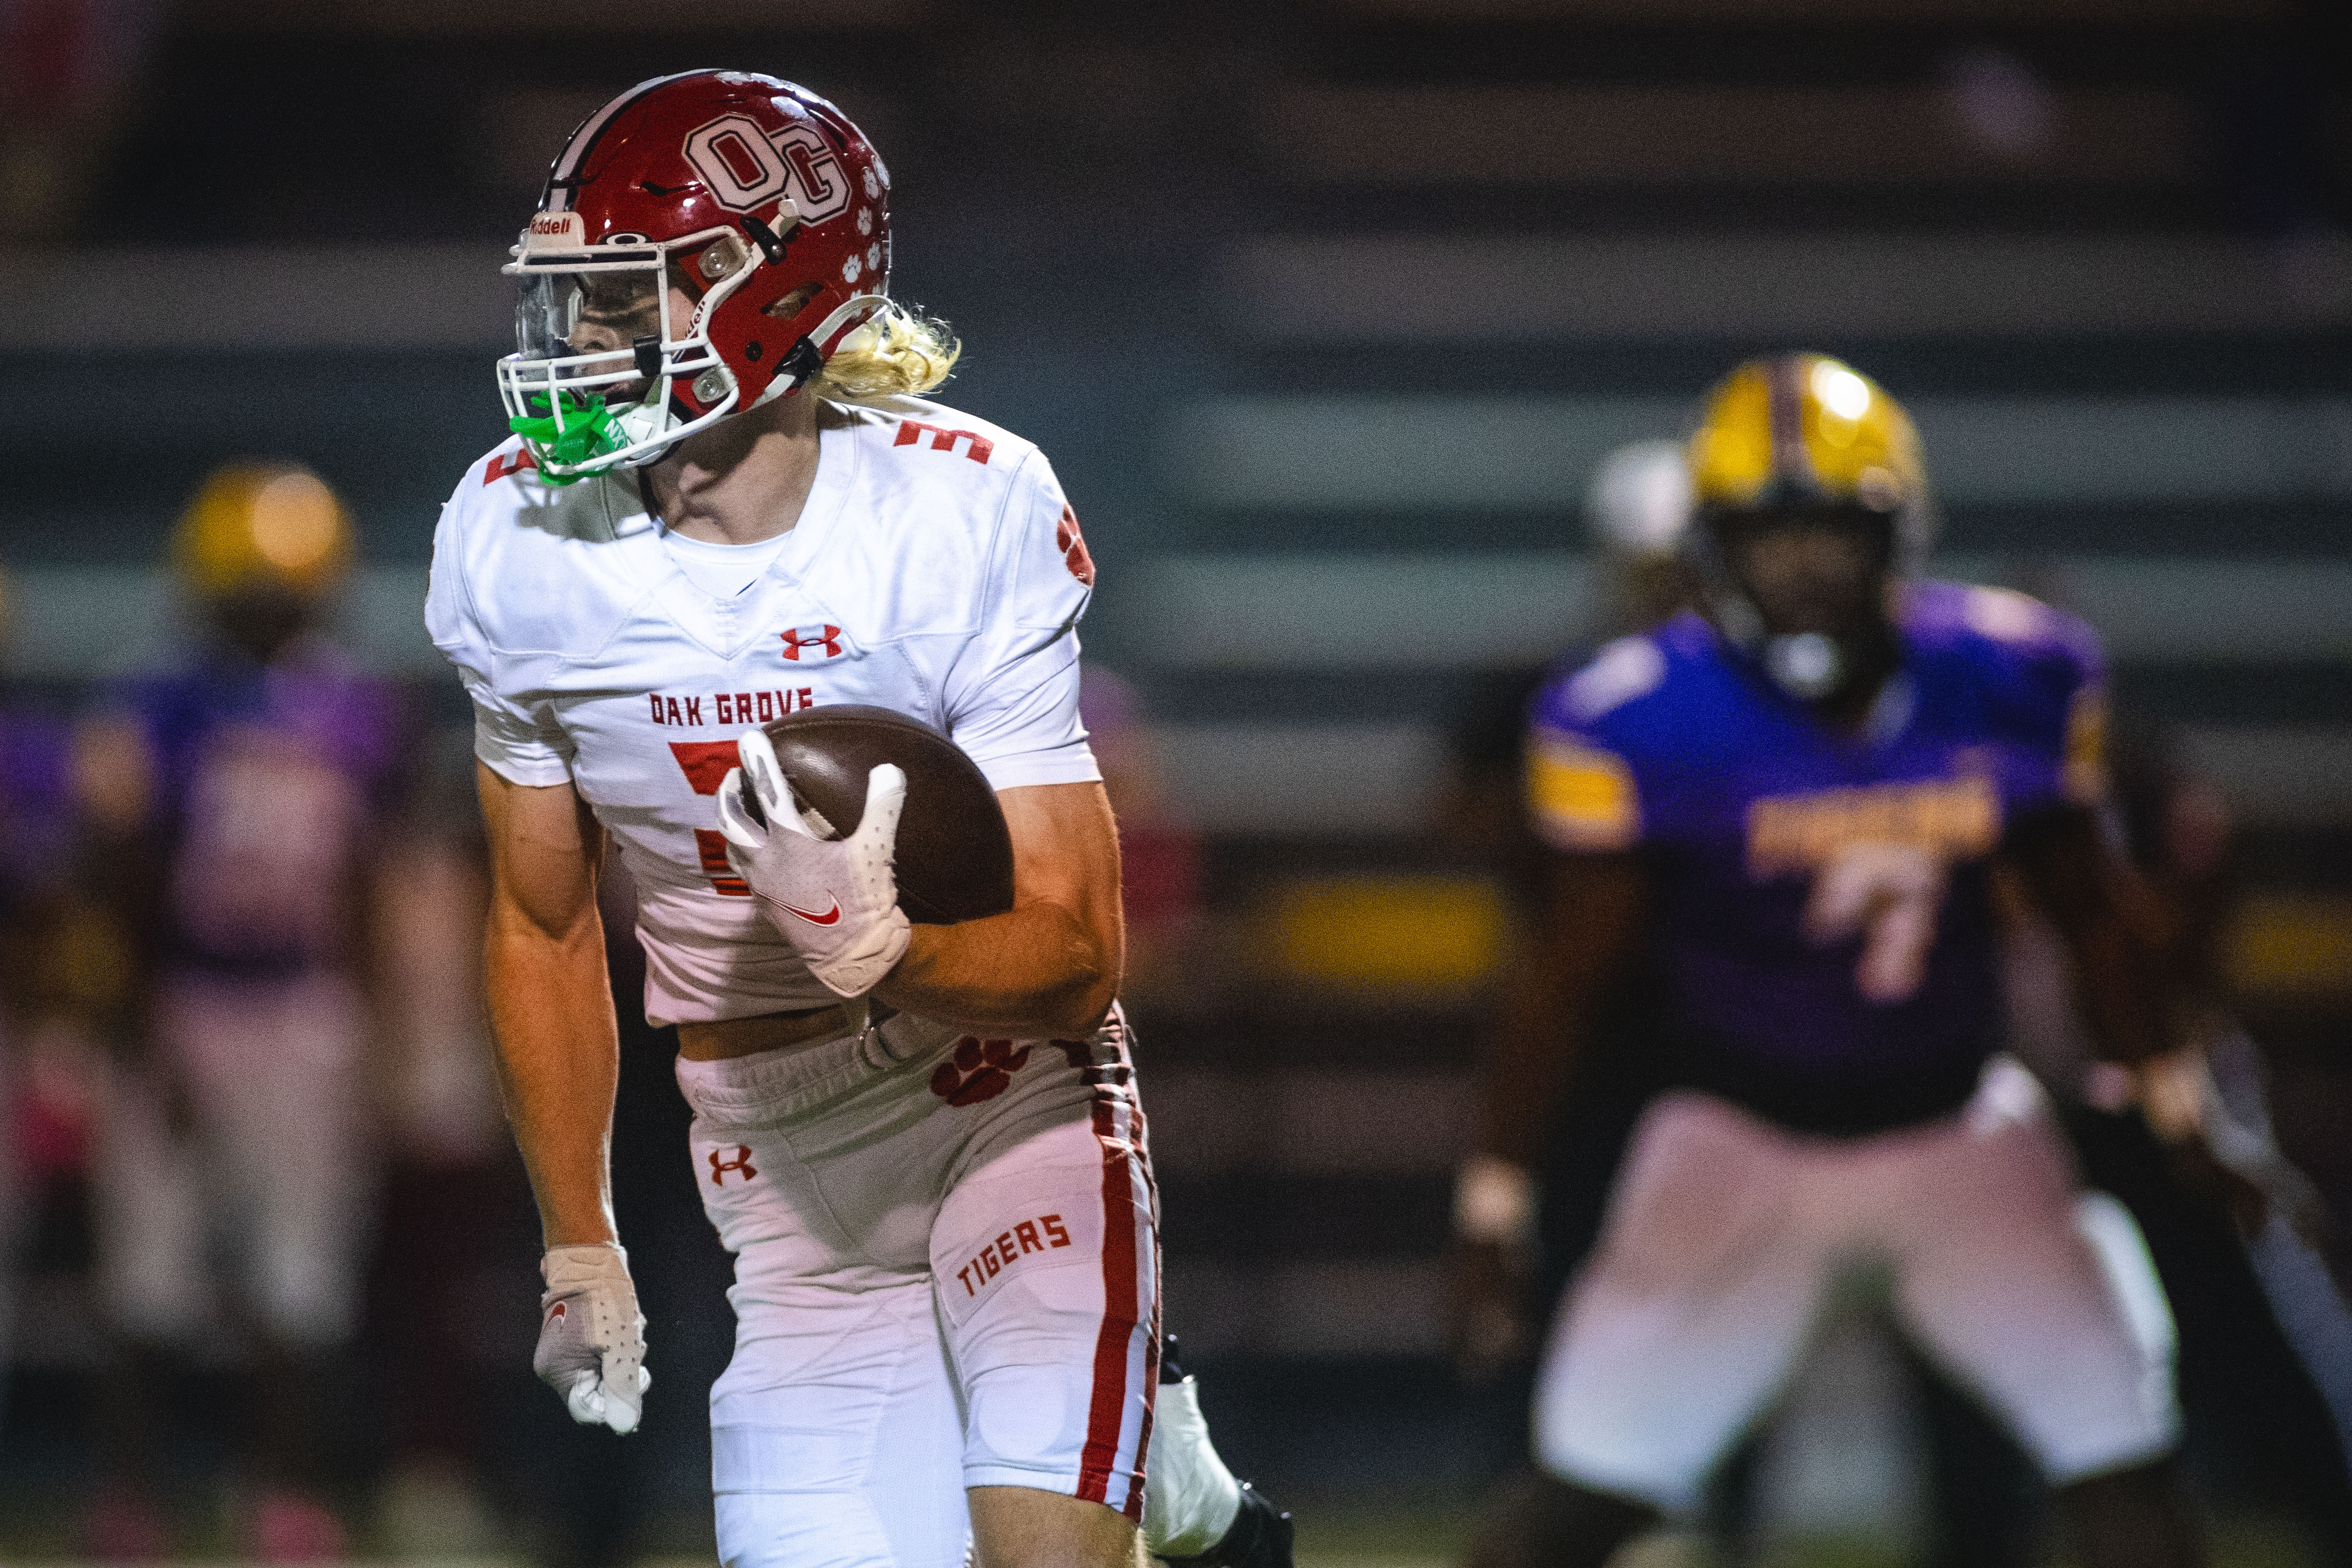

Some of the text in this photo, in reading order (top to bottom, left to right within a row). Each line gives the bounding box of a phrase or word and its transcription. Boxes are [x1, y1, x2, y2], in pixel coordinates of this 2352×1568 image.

[681, 111, 852, 227] OG
[604, 418, 627, 449] NX
[650, 687, 813, 726] OAK GROVE
[956, 1214, 1071, 1297] TIGERS
